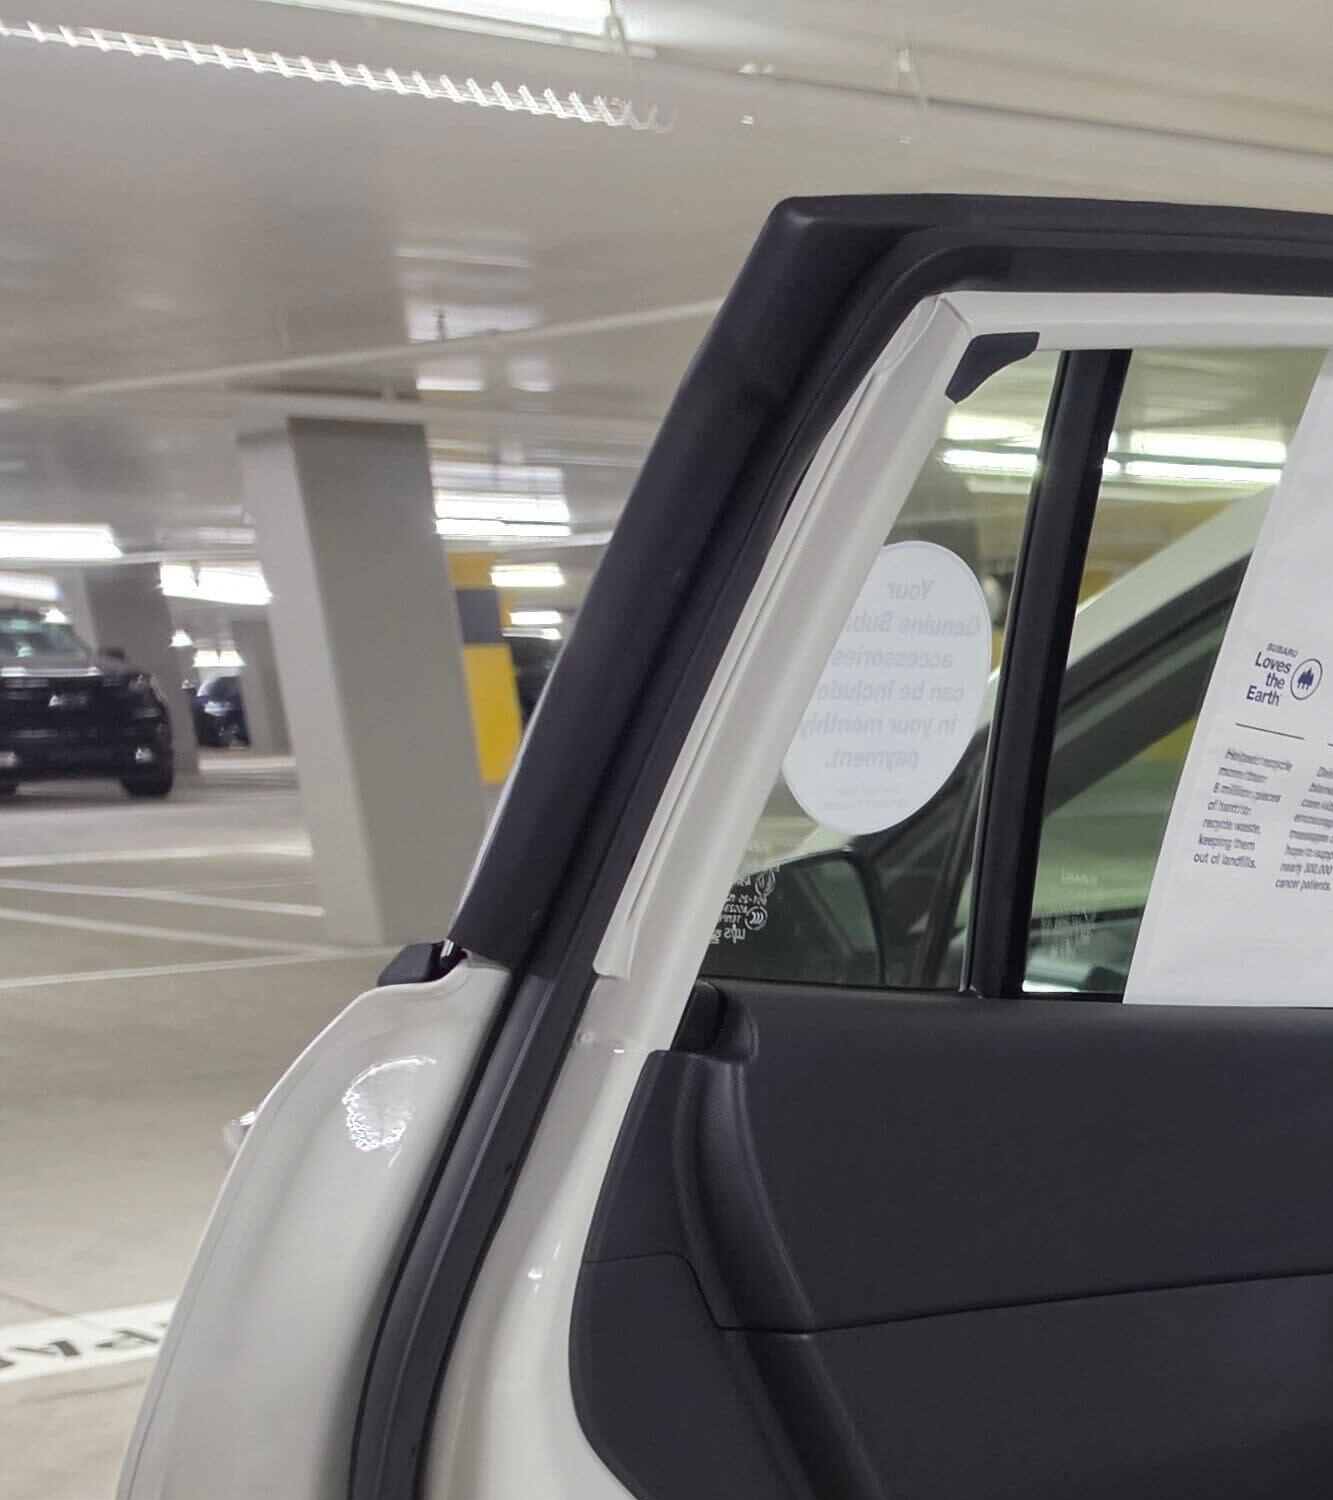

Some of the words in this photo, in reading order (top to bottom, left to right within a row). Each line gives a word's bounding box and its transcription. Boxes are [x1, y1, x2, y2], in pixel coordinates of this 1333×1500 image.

[1255, 651, 1292, 675] Loves
[1265, 673, 1285, 690] the
[1246, 685, 1280, 706] Earth
